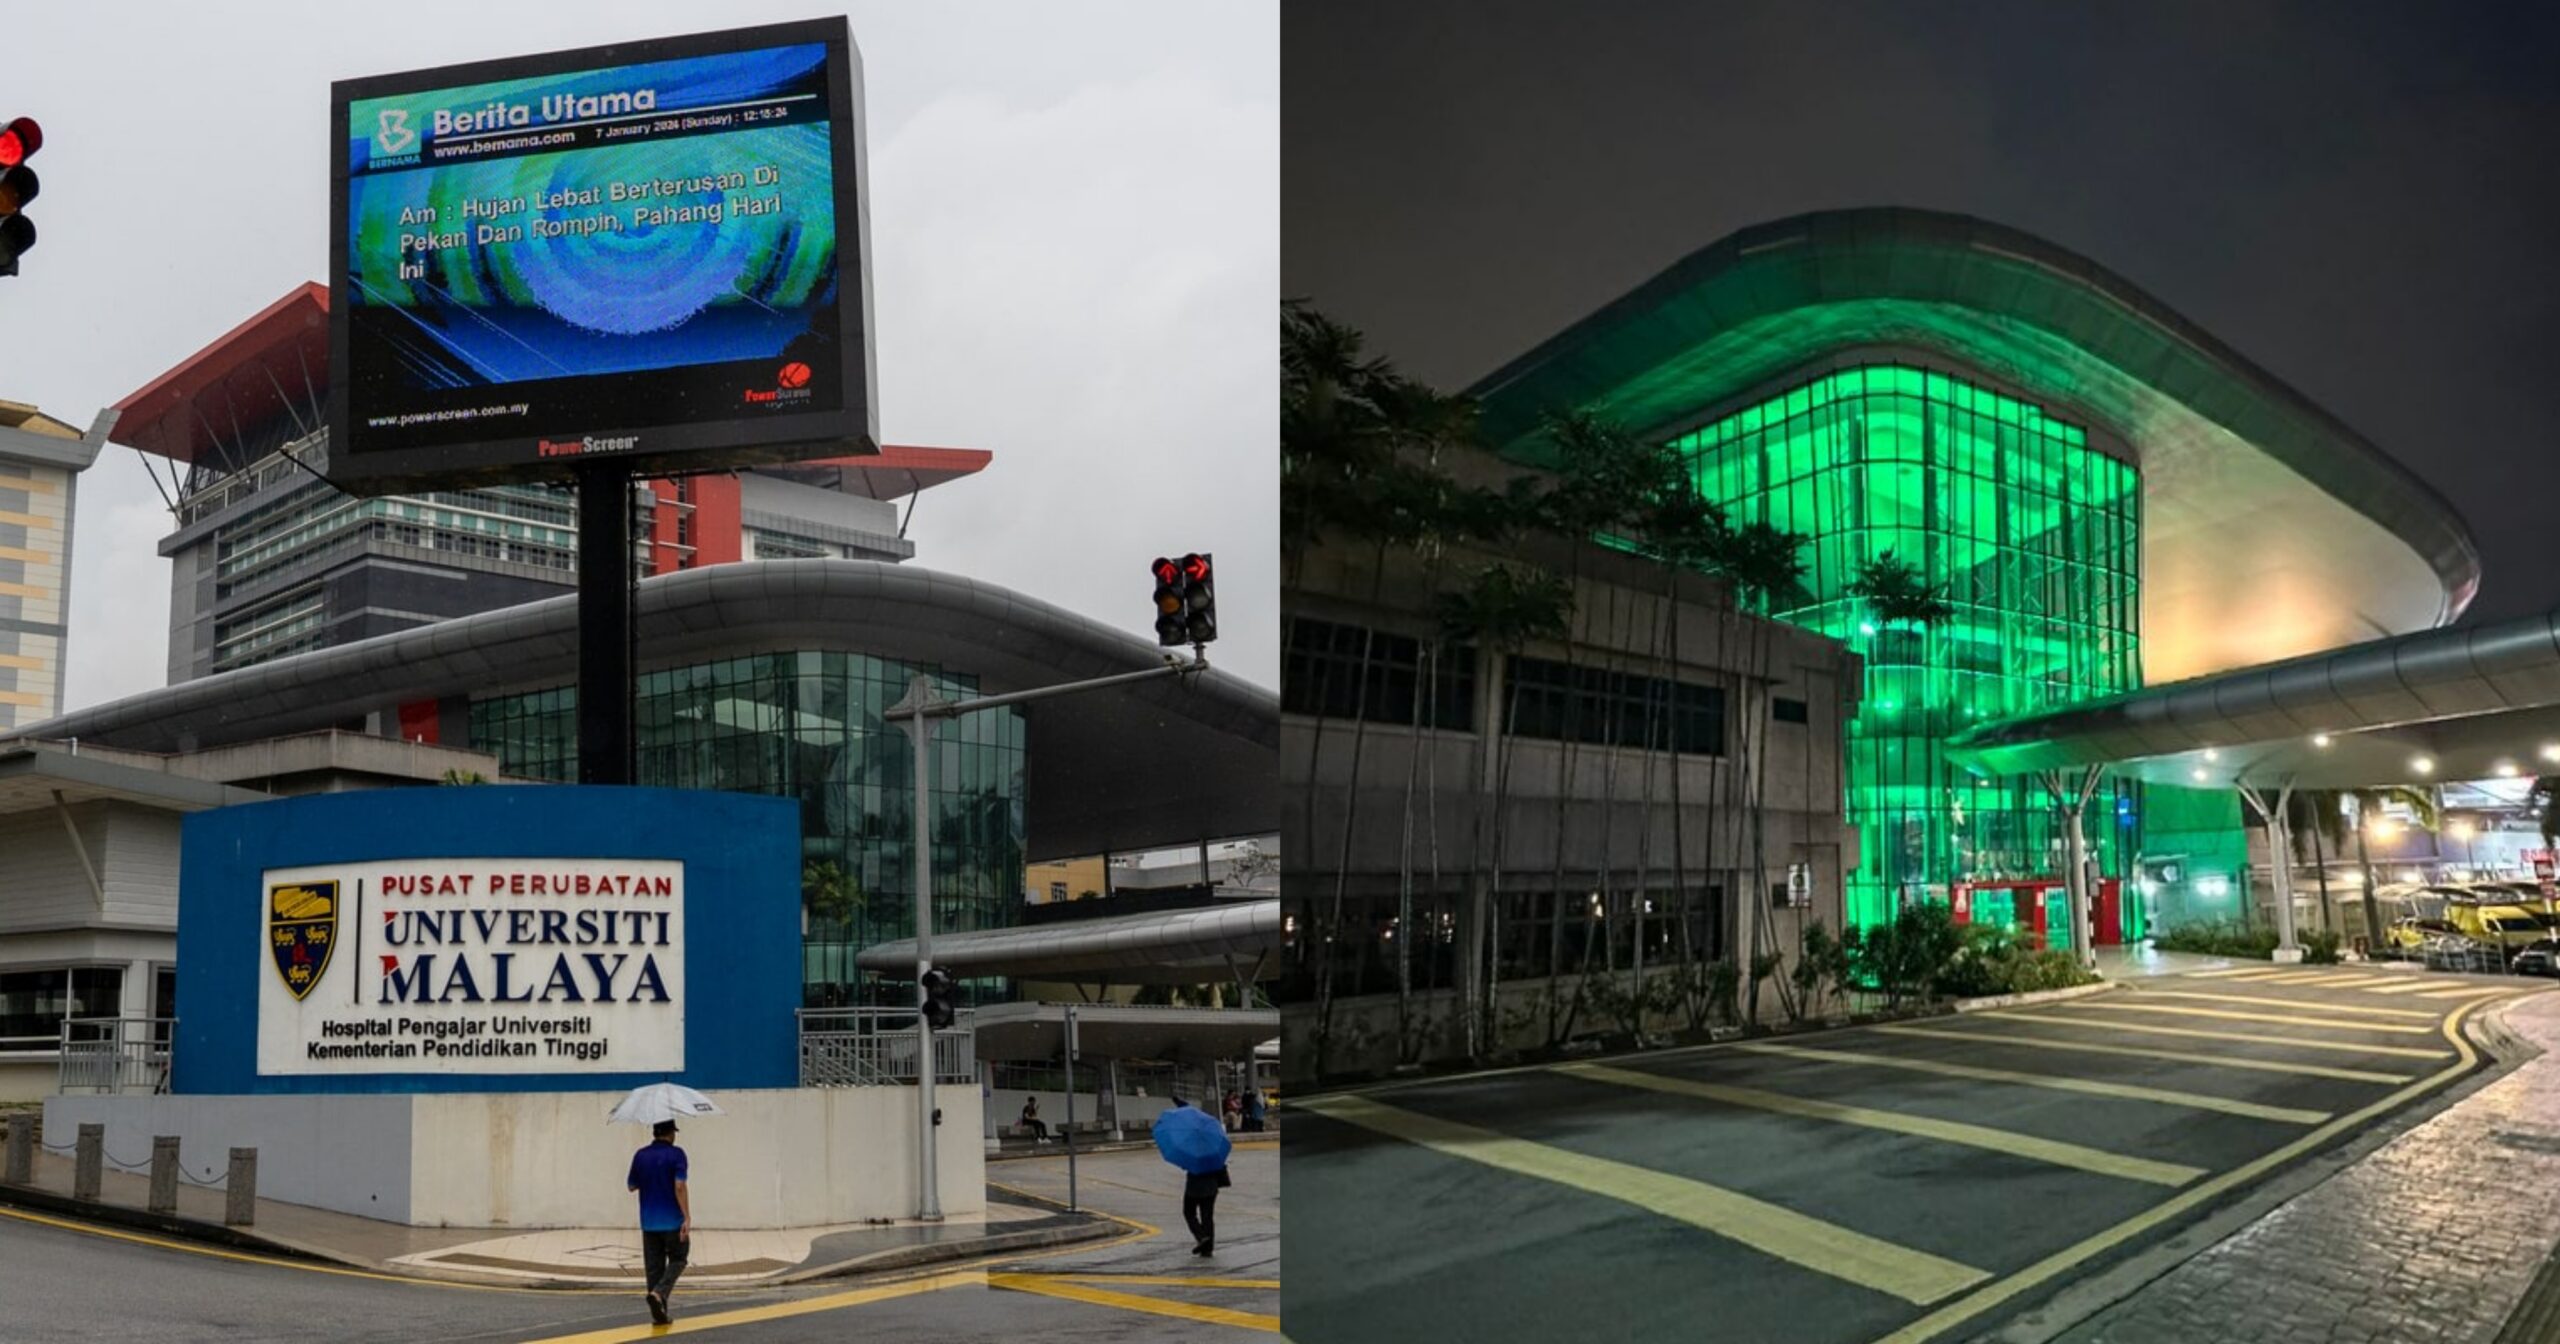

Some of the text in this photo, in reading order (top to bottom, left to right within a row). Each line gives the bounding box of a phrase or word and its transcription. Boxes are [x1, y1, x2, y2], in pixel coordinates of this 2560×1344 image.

[433, 88, 656, 135] Berita Utama
[606, 123, 652, 138] January
[681, 113, 732, 131] (Sunday)
[434, 131, 576, 158] www.bernama.com
[369, 155, 421, 169] BERNAMA
[400, 206, 437, 225] Am
[462, 197, 526, 220] Hujan
[536, 187, 602, 210] Lebat
[610, 173, 746, 202] Berterusan
[754, 165, 780, 186] Di
[401, 193, 782, 253] Pekan Dan Rompin, Pahang Hari
[400, 261, 424, 280] Ini
[369, 403, 529, 427] www.powerscreen.com.my
[538, 435, 634, 457] PowerScreen
[382, 874, 672, 897] PUSAT PERUBATAN
[384, 909, 670, 946] UNIVERSITI
[378, 952, 673, 1005] MALAYA
[322, 1016, 591, 1039] Hospital Pengajar Universiti
[307, 1037, 608, 1060] Kementerian Pendidikan Tinggi
